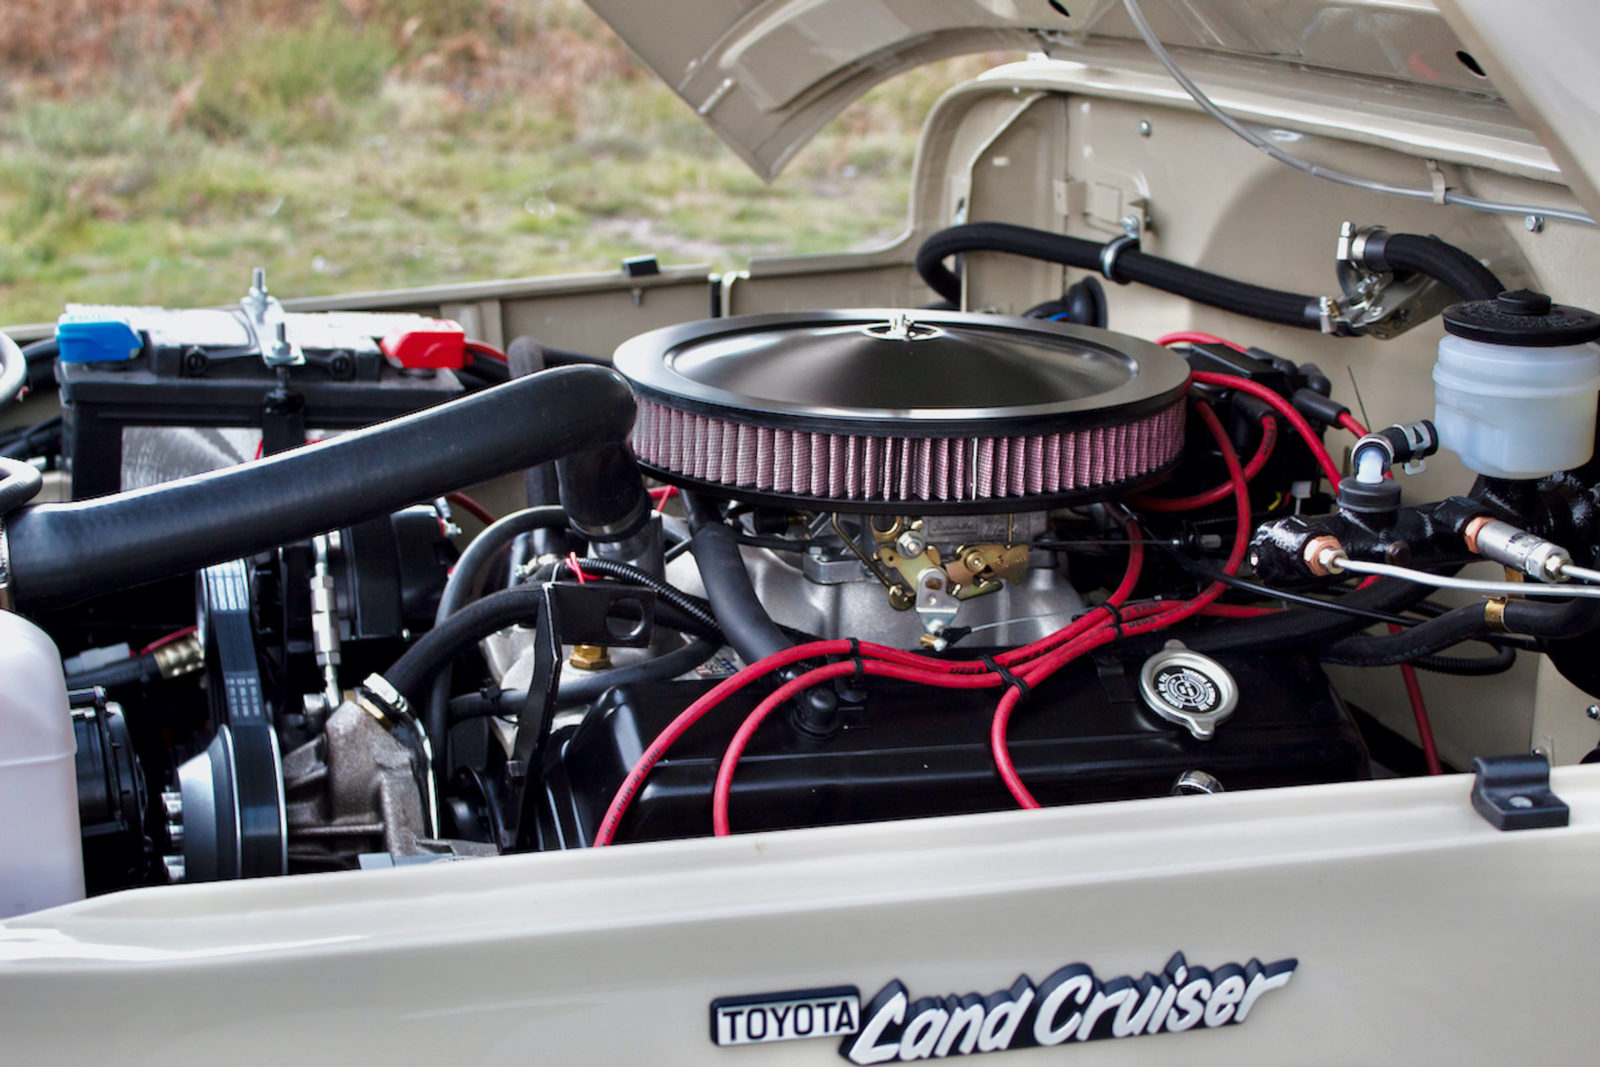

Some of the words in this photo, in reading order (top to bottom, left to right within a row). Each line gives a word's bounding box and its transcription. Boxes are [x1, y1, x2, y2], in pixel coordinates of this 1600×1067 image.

[721, 1002, 855, 1042] TOYOTA
[847, 982, 1034, 1066] Land
[1032, 963, 1295, 1047] Cruiser
